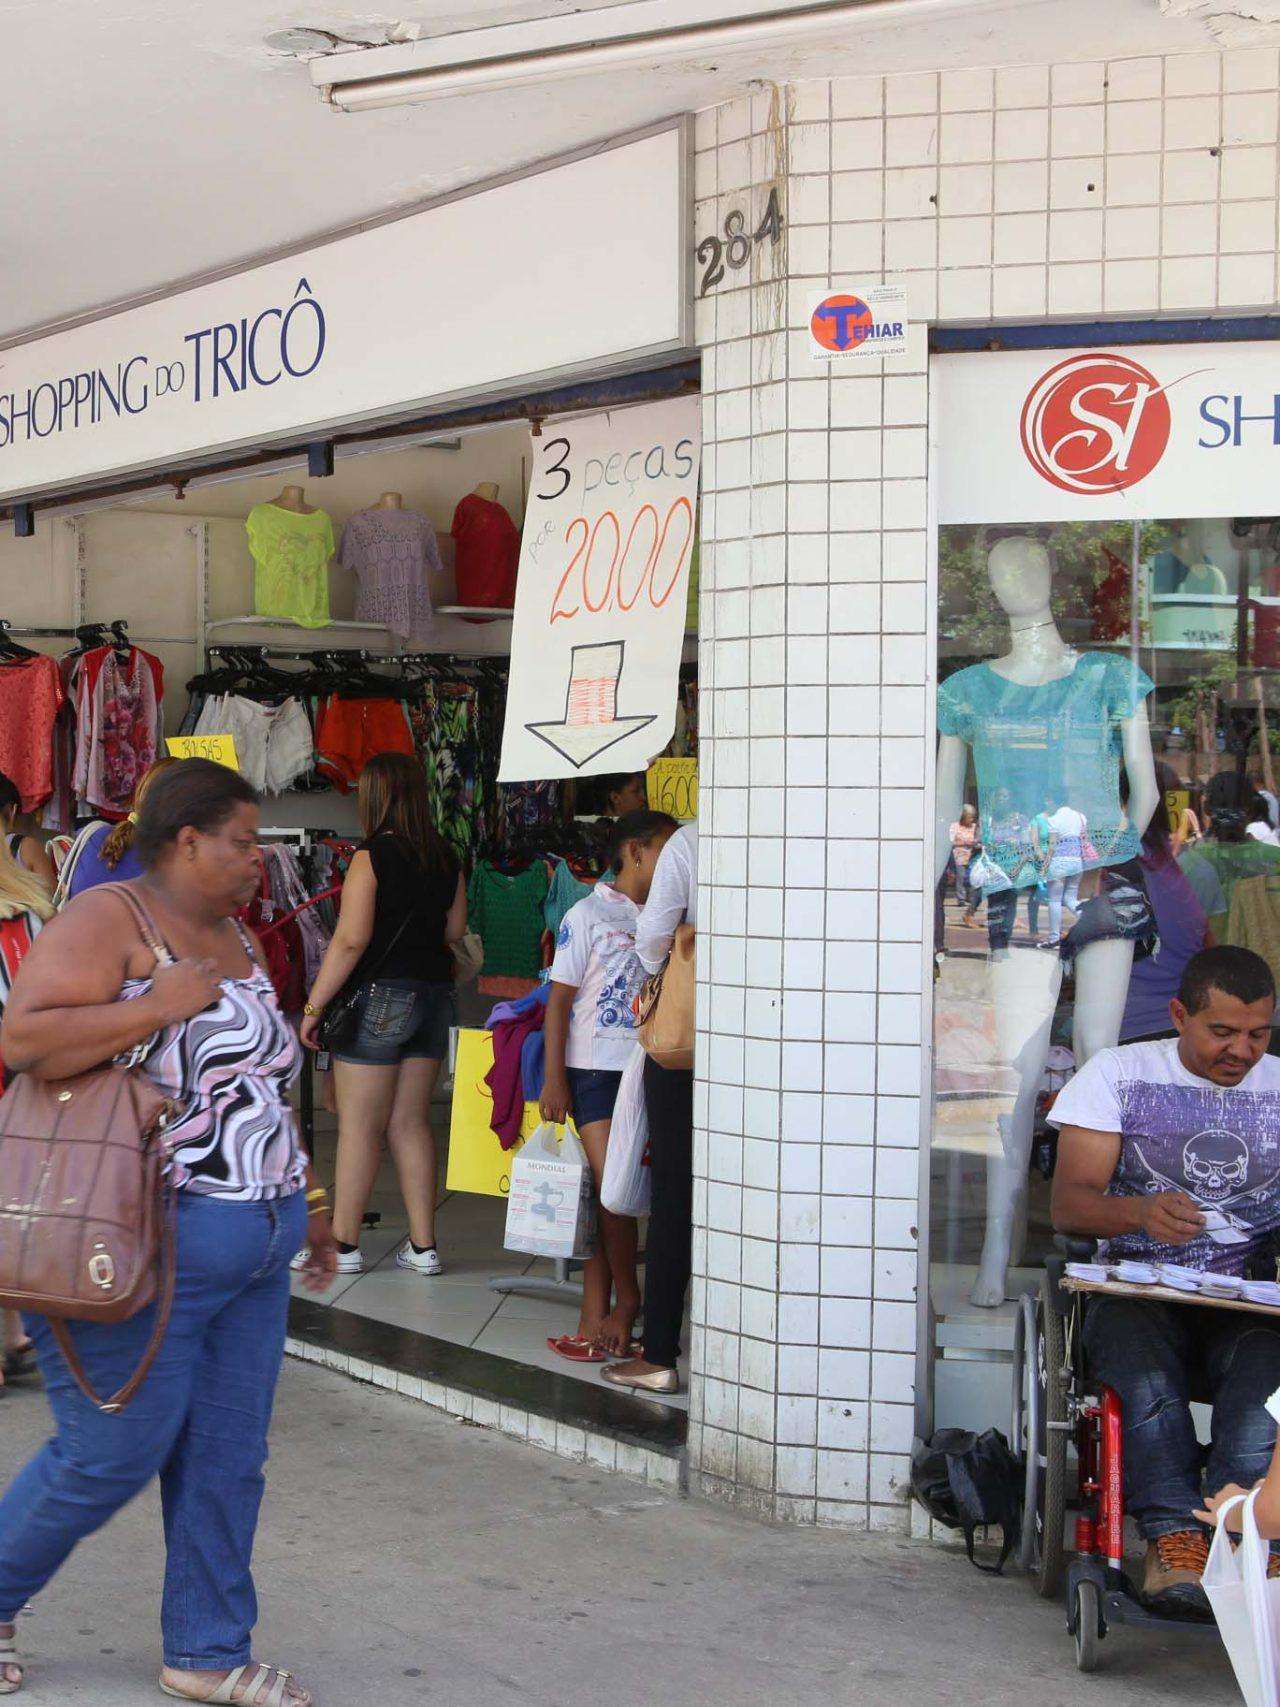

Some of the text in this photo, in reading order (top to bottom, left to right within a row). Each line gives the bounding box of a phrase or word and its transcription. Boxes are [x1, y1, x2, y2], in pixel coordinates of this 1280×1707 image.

[698, 187, 783, 298] 284
[155, 361, 185, 397] DO
[184, 276, 326, 402] TRICÔ
[536, 437, 693, 517] 3 peças
[526, 1162, 567, 1174] MONDIAL
